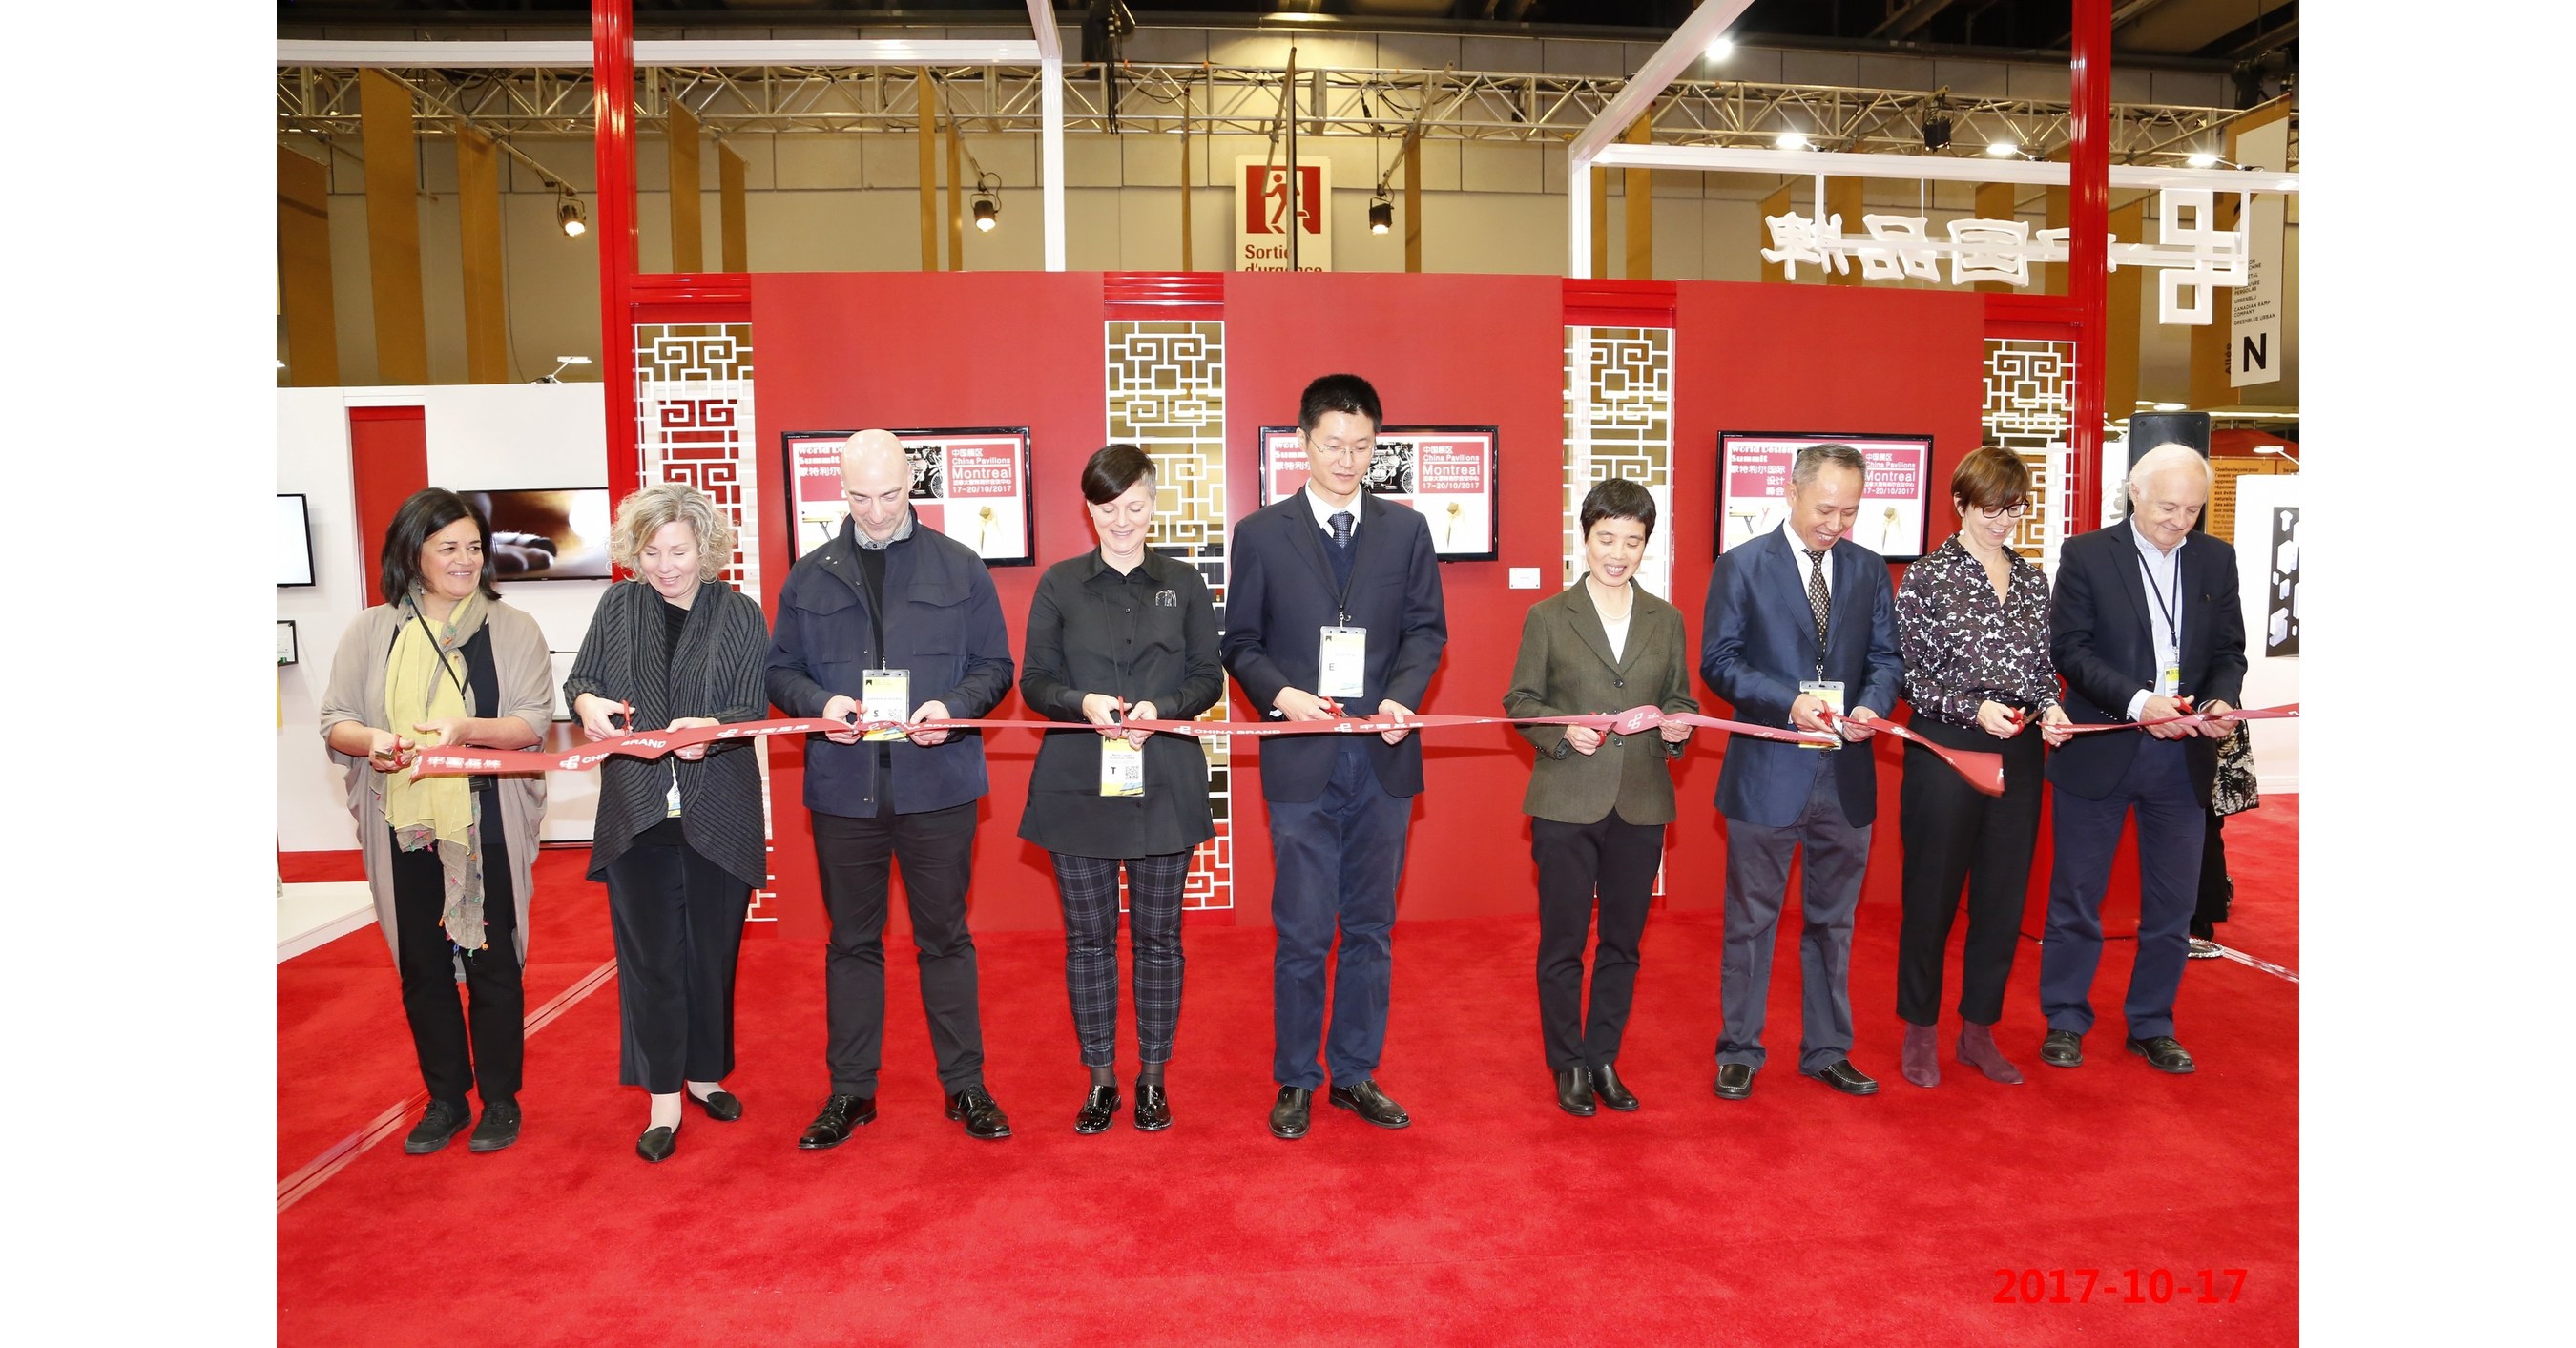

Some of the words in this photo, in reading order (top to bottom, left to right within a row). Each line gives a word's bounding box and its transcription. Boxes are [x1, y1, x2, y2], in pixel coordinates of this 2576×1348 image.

[2233, 303, 2257, 312] CANADIAN
[2233, 309, 2254, 318] COMPANY
[2243, 333, 2266, 373] N
[799, 456, 841, 465] Summit
[952, 467, 1011, 479] Montreal
[1423, 464, 1480, 475] Montreal
[1865, 470, 1916, 482] Montreal
